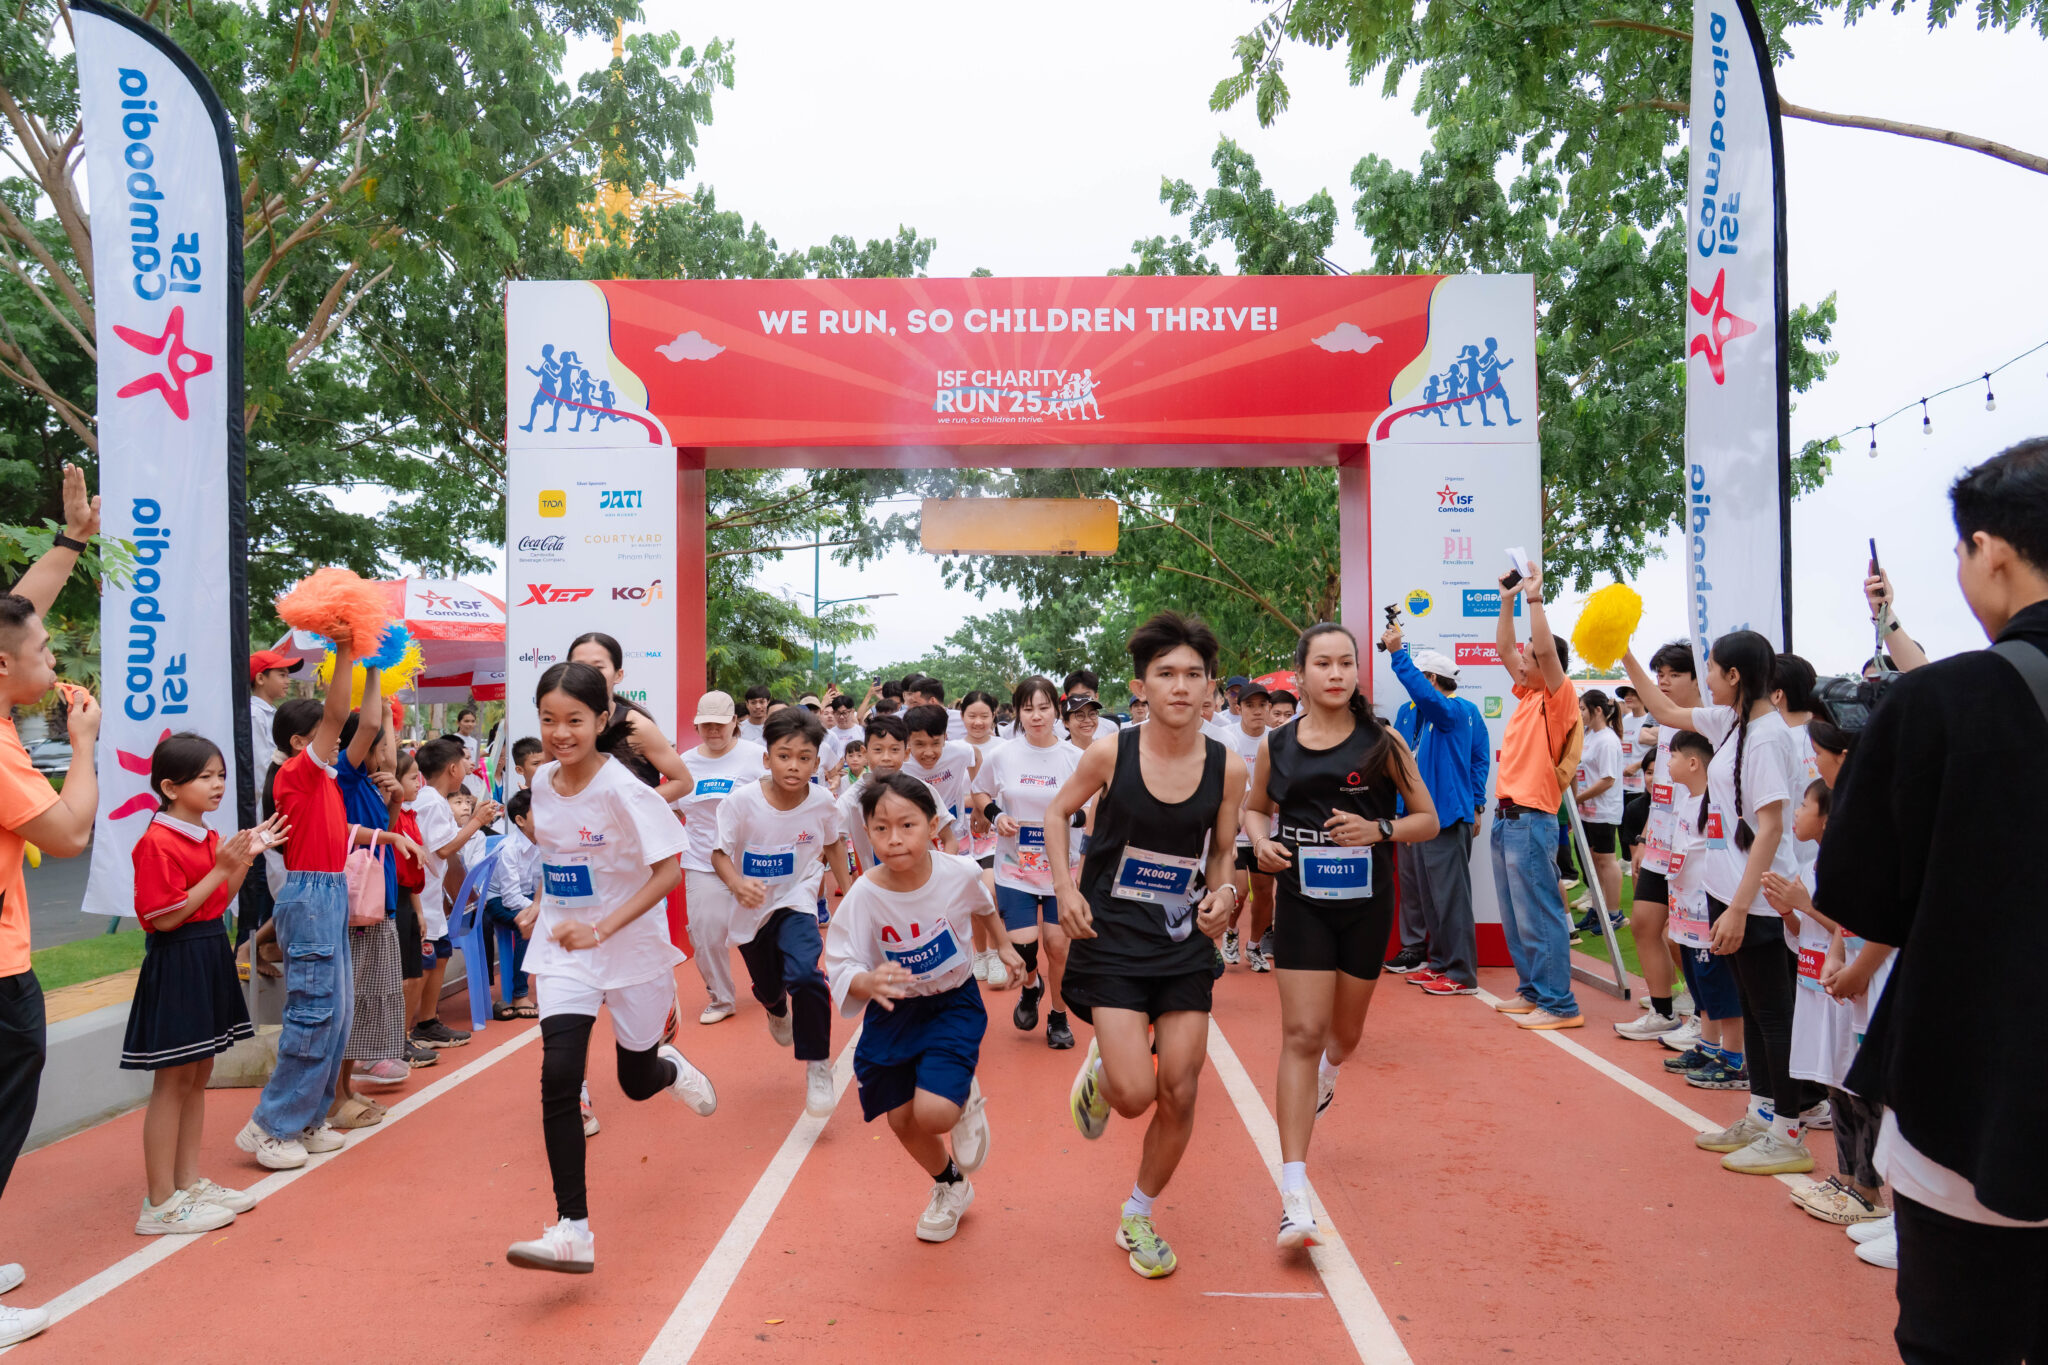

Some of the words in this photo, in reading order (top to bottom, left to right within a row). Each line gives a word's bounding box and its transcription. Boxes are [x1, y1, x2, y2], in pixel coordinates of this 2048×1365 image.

[758, 309, 808, 335] WE
[819, 309, 897, 337] RUN,
[907, 308, 954, 334] SO
[963, 307, 1135, 333] CHILDREN
[1146, 306, 1278, 332] THRIVE!
[937, 369, 968, 387] ISF
[971, 369, 1068, 387] CHARITY
[981, 415, 1016, 424] children
[542, 500, 564, 508] TADA
[600, 489, 642, 509] JATI
[1457, 495, 1474, 505] ISF
[584, 534, 663, 544] COURTYARD
[1443, 536, 1473, 560] PH
[515, 583, 595, 607] XTEP
[453, 600, 483, 610] ISF
[425, 609, 490, 618] Cambodia
[591, 834, 604, 842] ISF
[751, 858, 783, 867] 7K0215
[1136, 867, 1178, 881] 7K0002
[1316, 864, 1355, 874] 7K0211
[899, 943, 940, 965] 7K0217
